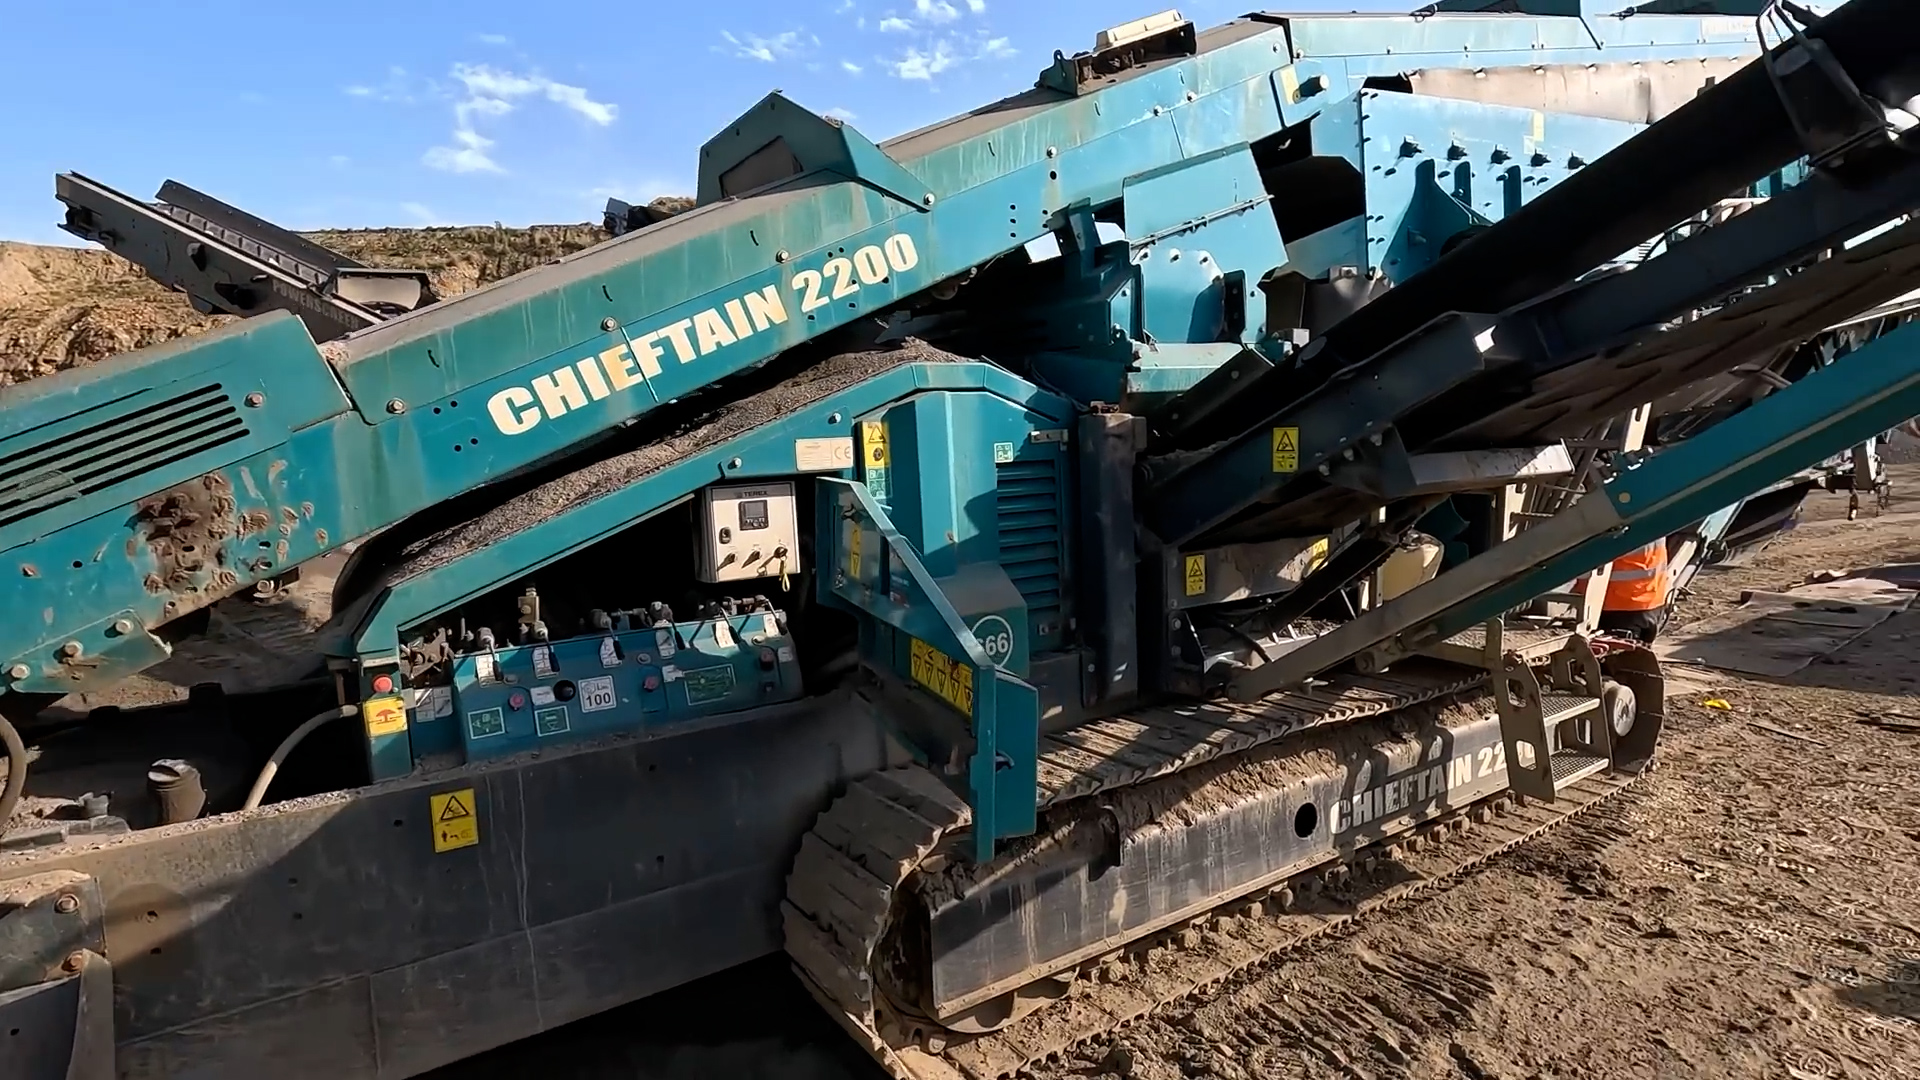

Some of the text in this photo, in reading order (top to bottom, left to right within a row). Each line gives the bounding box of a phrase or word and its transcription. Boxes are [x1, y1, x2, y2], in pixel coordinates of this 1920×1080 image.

[486, 232, 920, 437] CHIEFTAIN 2200
[976, 632, 1009, 656] 66
[585, 692, 611, 707] 100
[1330, 753, 1472, 834] CHIEFTAIN
